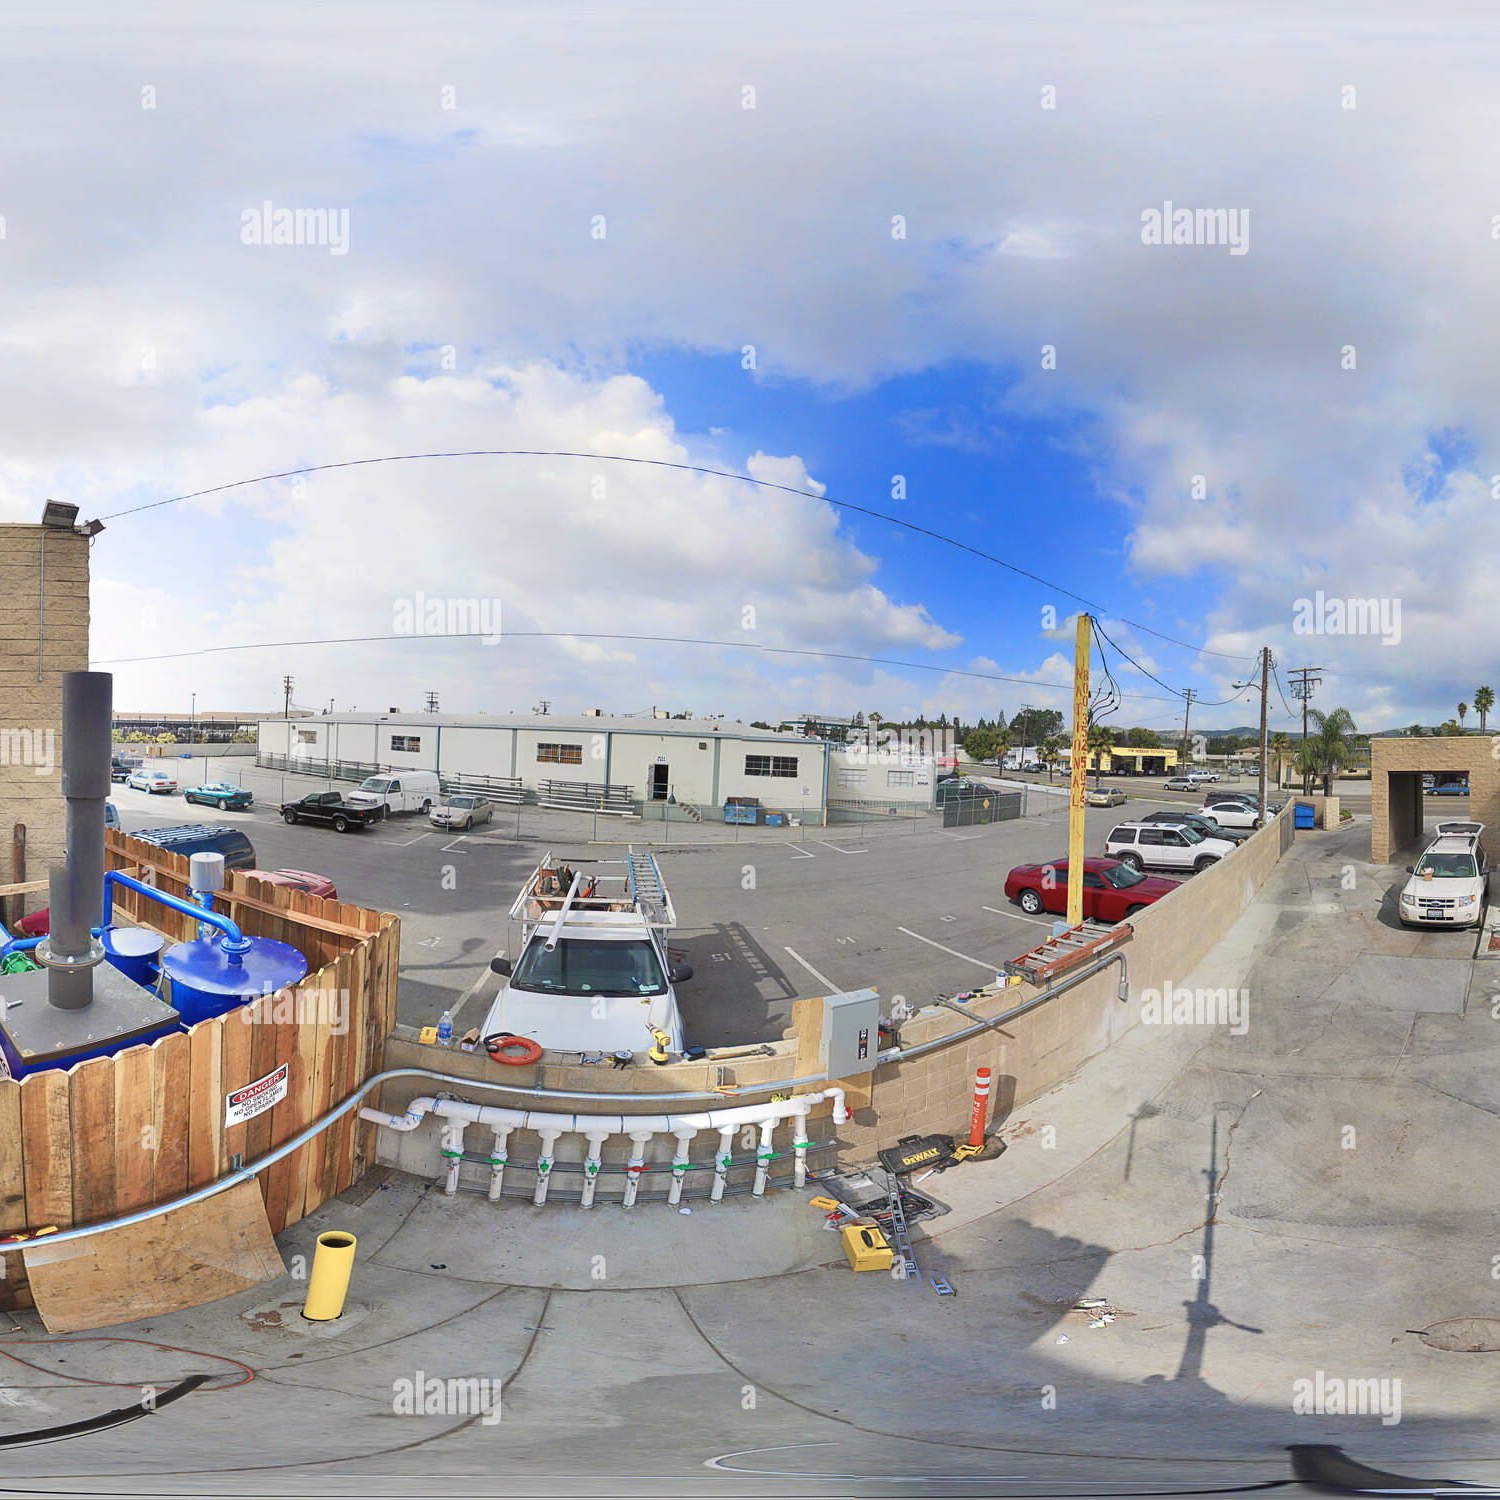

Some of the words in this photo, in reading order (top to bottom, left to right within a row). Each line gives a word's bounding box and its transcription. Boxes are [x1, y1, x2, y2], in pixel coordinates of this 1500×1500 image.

[1071, 666, 1083, 808] NATIONAL
[239, 1074, 280, 1100] DANGER
[241, 1099, 252, 1108] NO
[252, 1084, 278, 1102] SMOKING
[233, 1108, 244, 1117] NO
[244, 1100, 262, 1112] OPEN
[262, 1085, 283, 1102] FLAMES
[243, 1109, 253, 1118] NO
[253, 1096, 276, 1113] SPARKS
